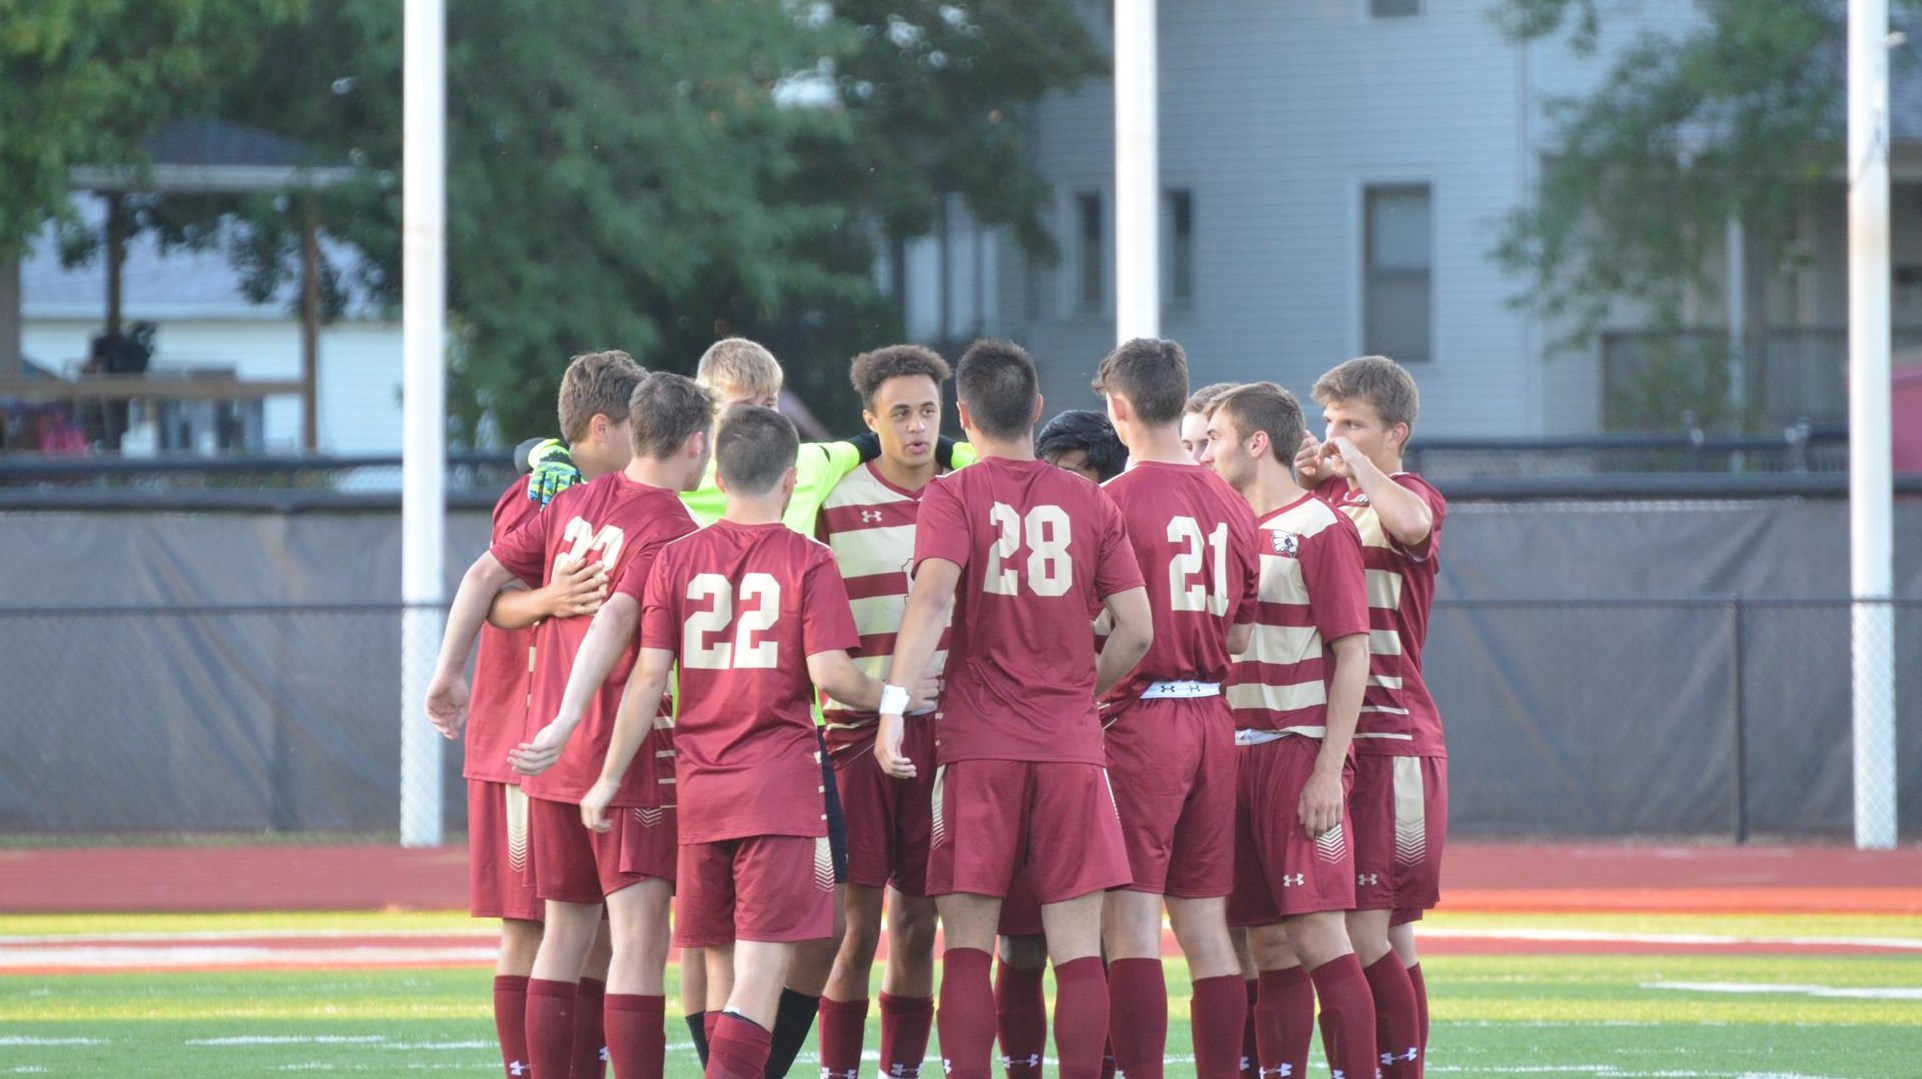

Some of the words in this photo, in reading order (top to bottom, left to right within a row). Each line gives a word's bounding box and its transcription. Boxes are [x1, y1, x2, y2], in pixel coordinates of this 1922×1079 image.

[983, 501, 1072, 597] 28
[1167, 516, 1229, 617] 21
[684, 573, 780, 669] 22
